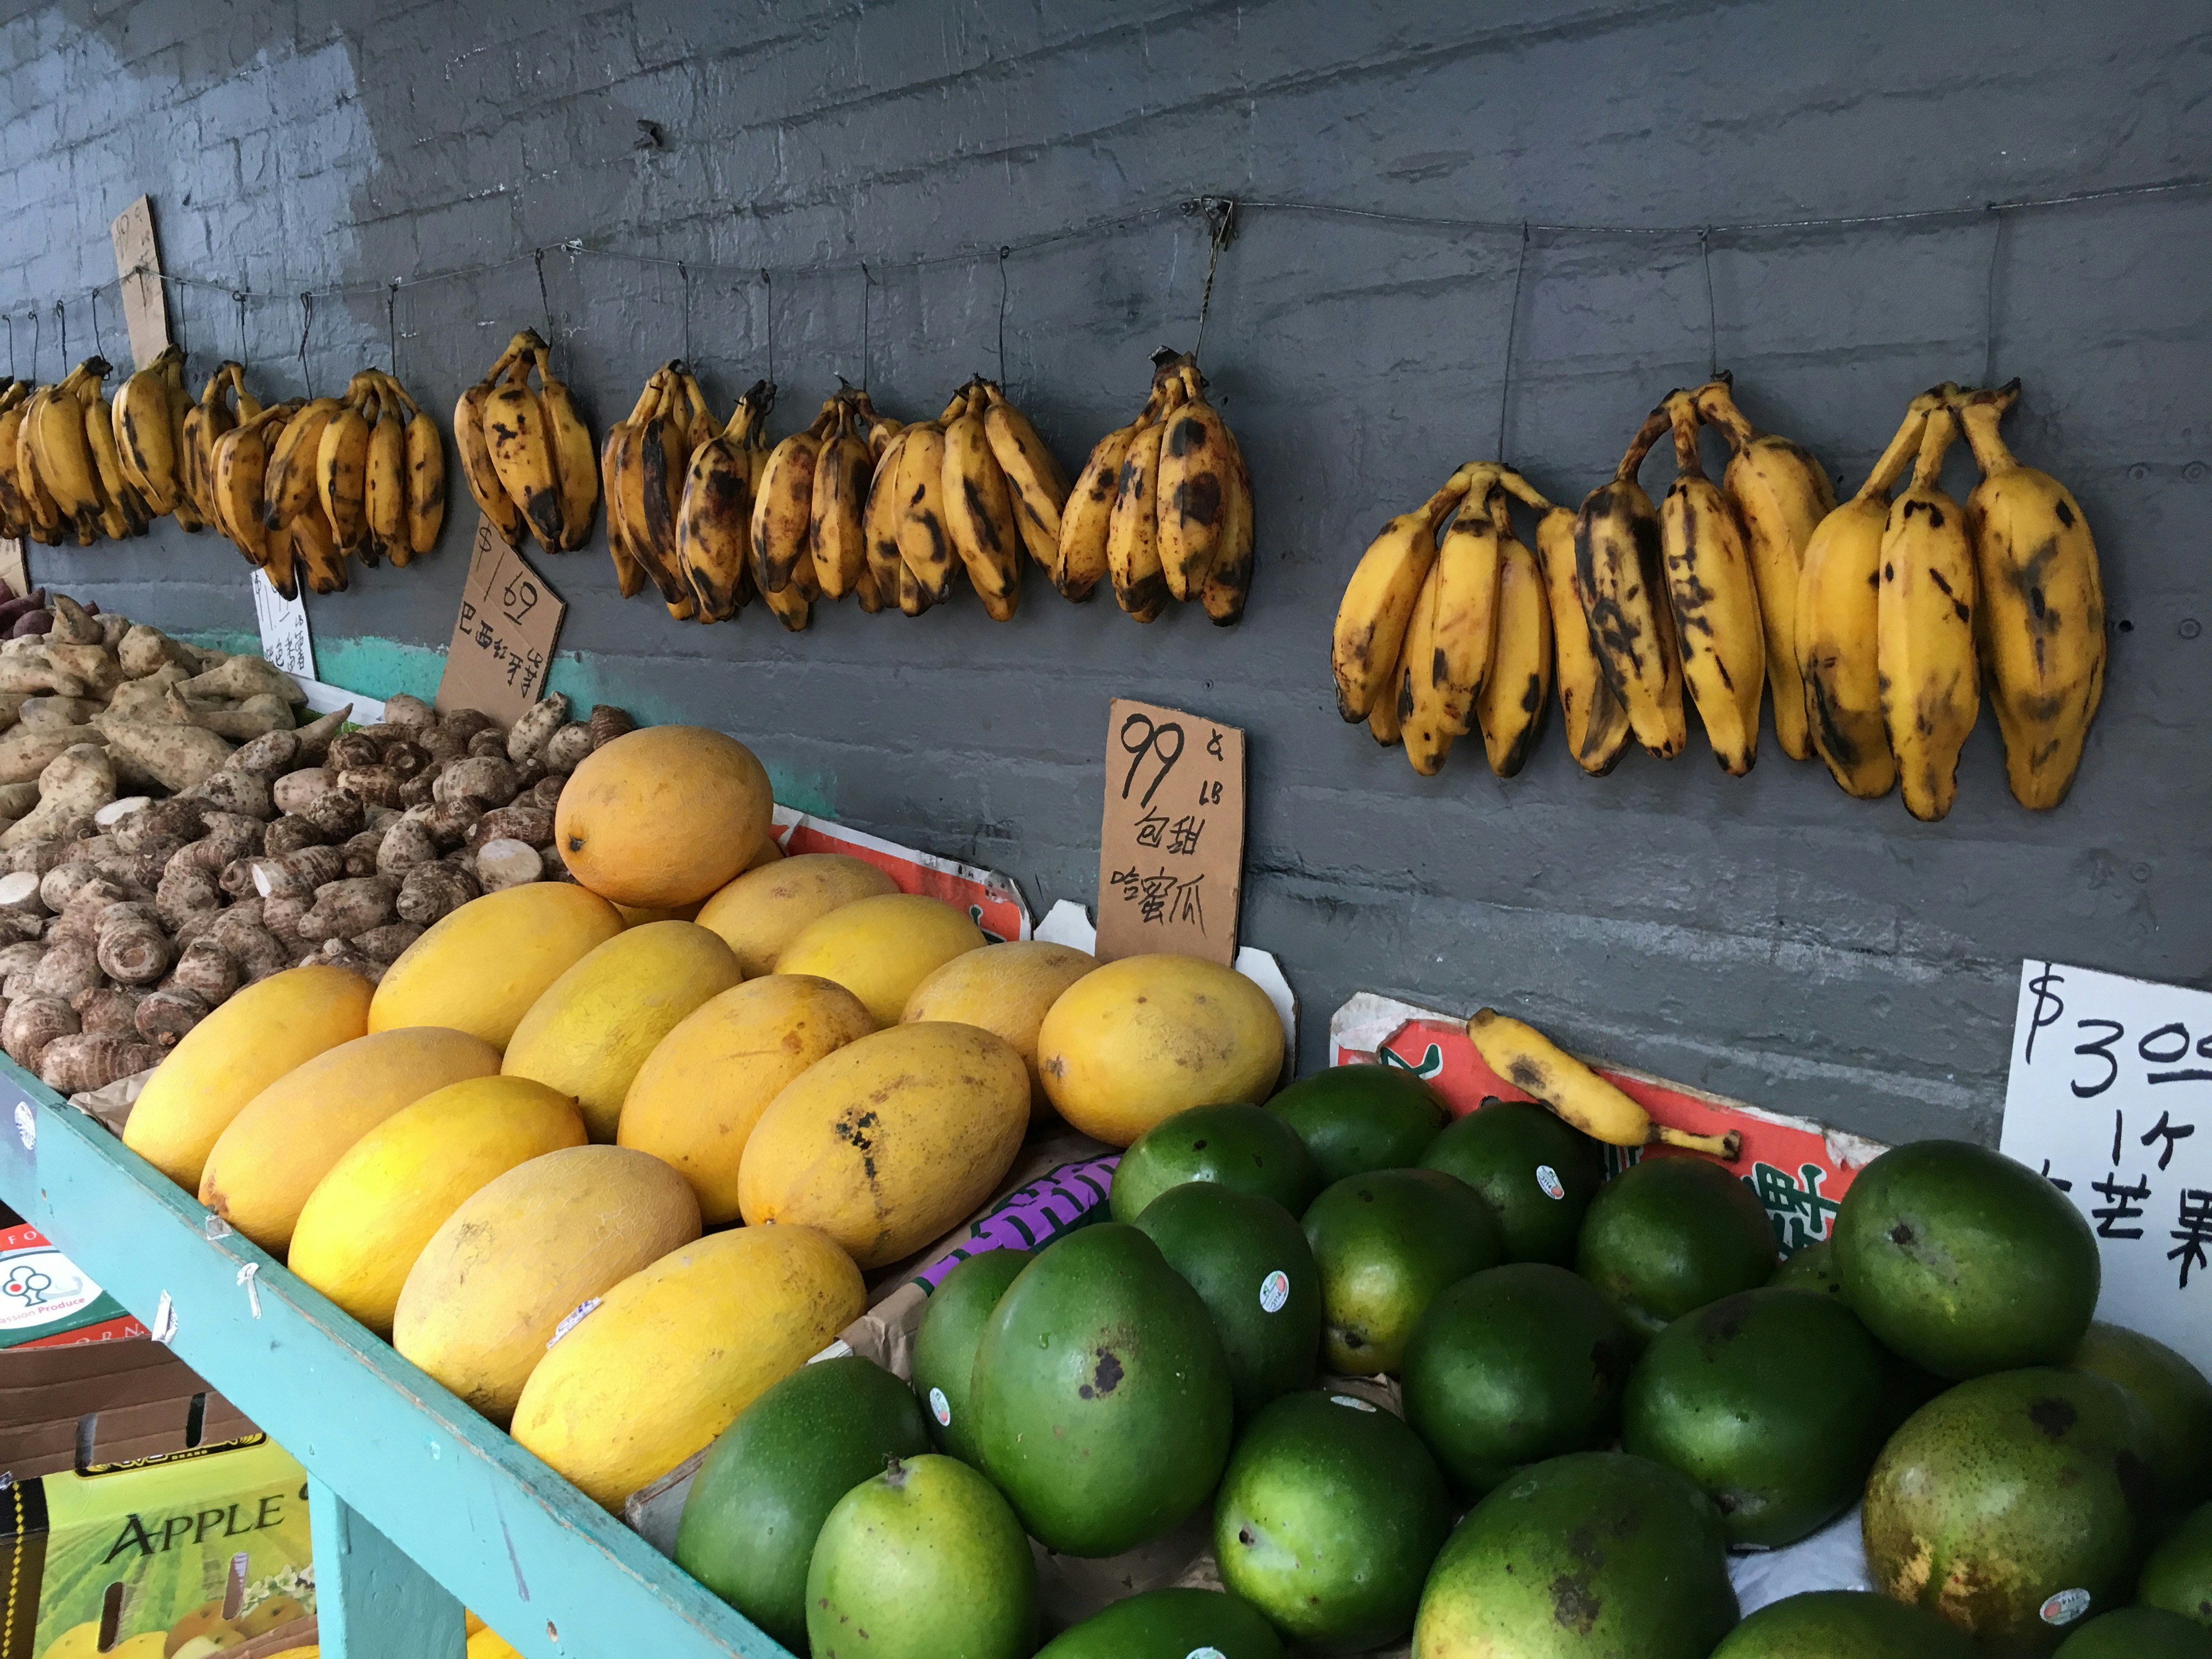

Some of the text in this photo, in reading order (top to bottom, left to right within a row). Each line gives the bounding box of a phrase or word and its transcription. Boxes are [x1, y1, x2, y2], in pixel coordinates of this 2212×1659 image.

[1121, 713, 1184, 809] 99
[1199, 780, 1223, 805] LB
[1134, 806, 1206, 855] 包甜
[1110, 866, 1207, 940] 哈蜜瓜
[2042, 1158, 2212, 1290] 芒果
[38, 1296, 86, 1314] Produce
[100, 1493, 285, 1565] APPLE
